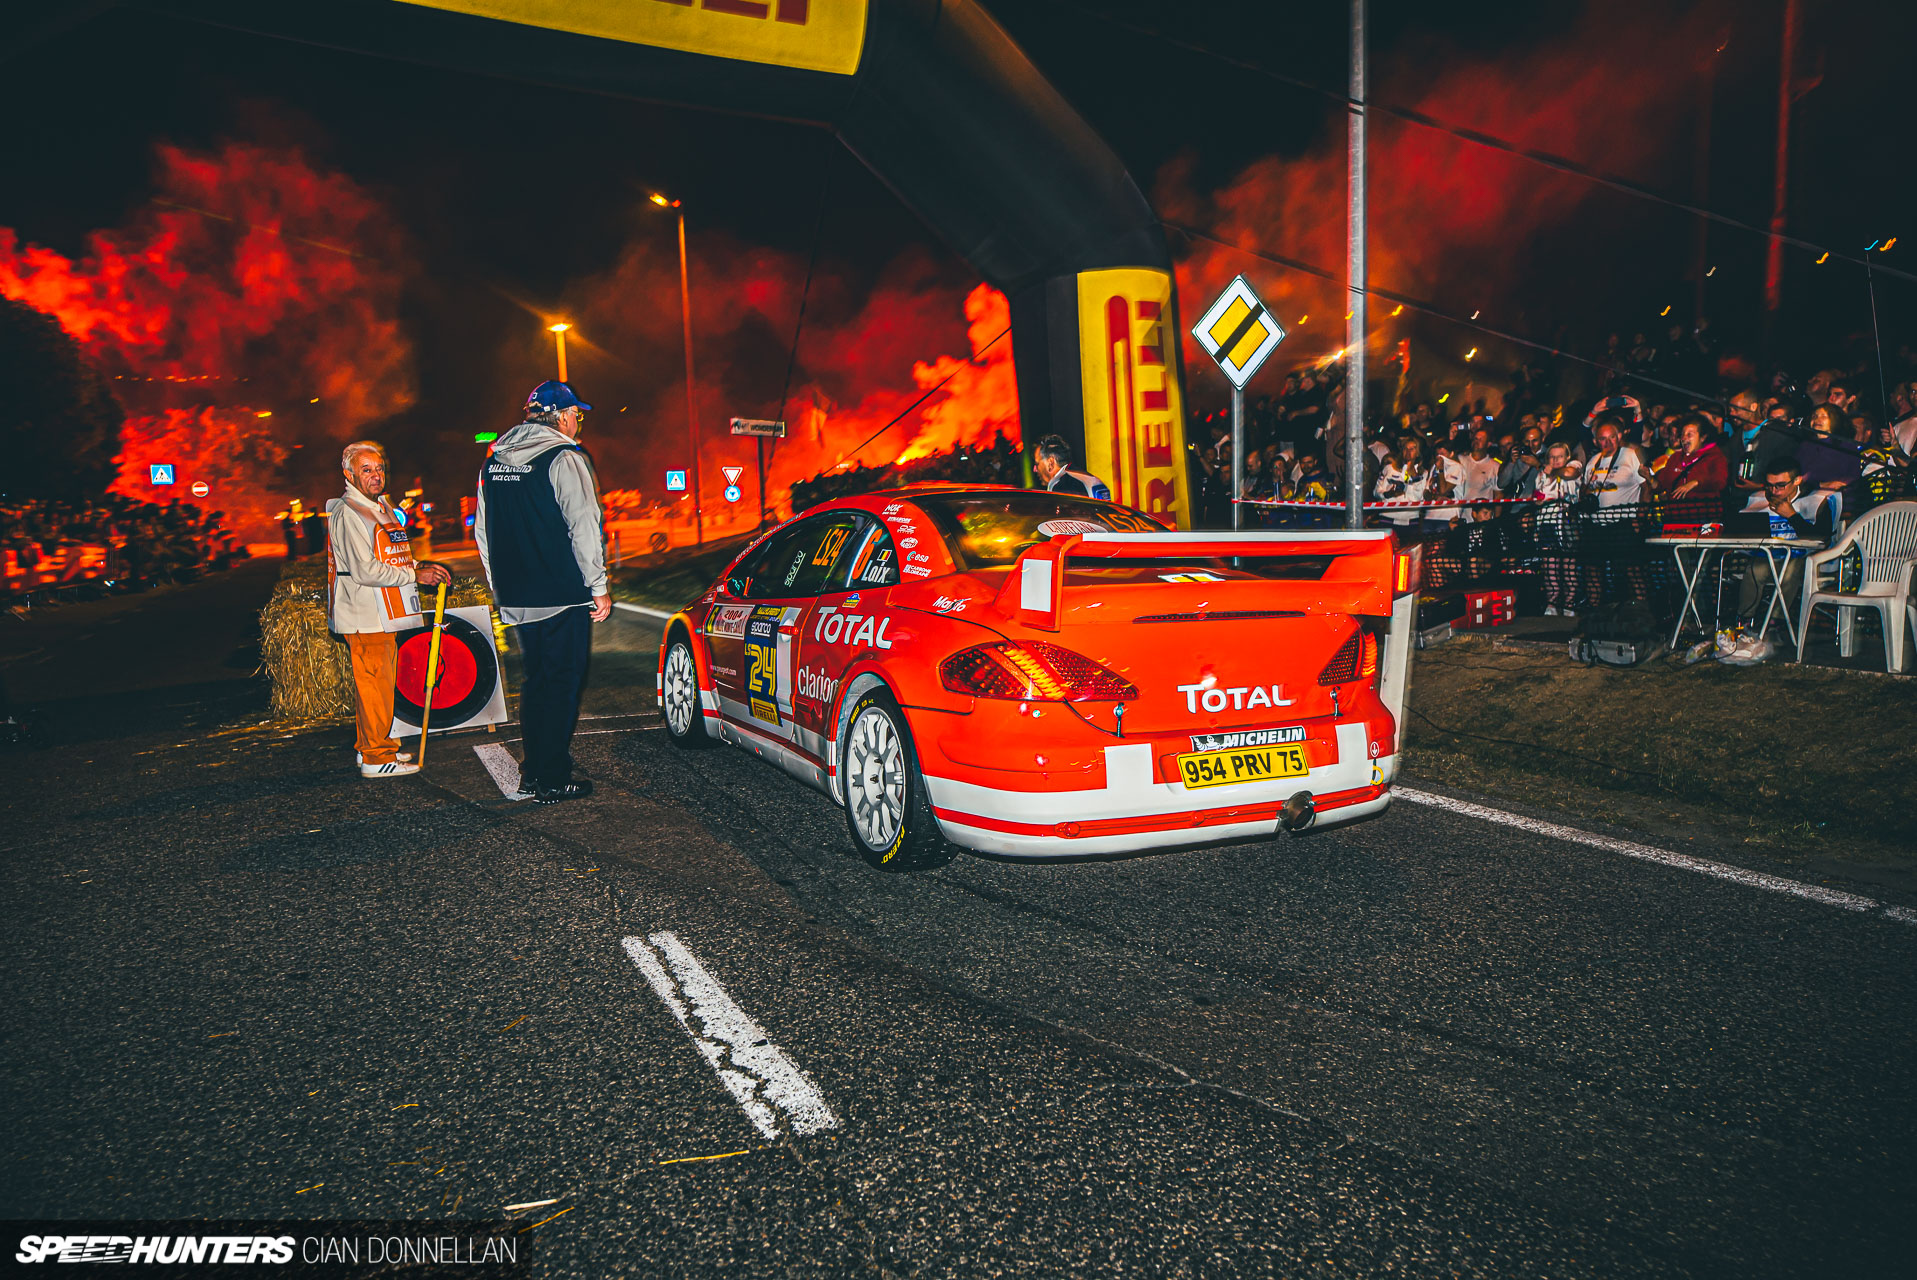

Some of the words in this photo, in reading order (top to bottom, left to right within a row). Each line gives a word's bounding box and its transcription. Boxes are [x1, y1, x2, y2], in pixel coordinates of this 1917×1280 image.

[811, 528, 850, 567] LS24
[851, 528, 884, 580] 6
[784, 550, 806, 587] sparco
[724, 610, 744, 620] 2004
[751, 622, 772, 636] sparco
[815, 606, 893, 650] TOTAL
[749, 643, 777, 696] 24
[752, 702, 777, 722] PIRELLI
[1177, 684, 1292, 714] TOTAL
[1223, 728, 1303, 748] MICHELIN
[1185, 757, 1227, 783] 954
[1231, 753, 1271, 777] PRV
[1277, 750, 1303, 772] 75
